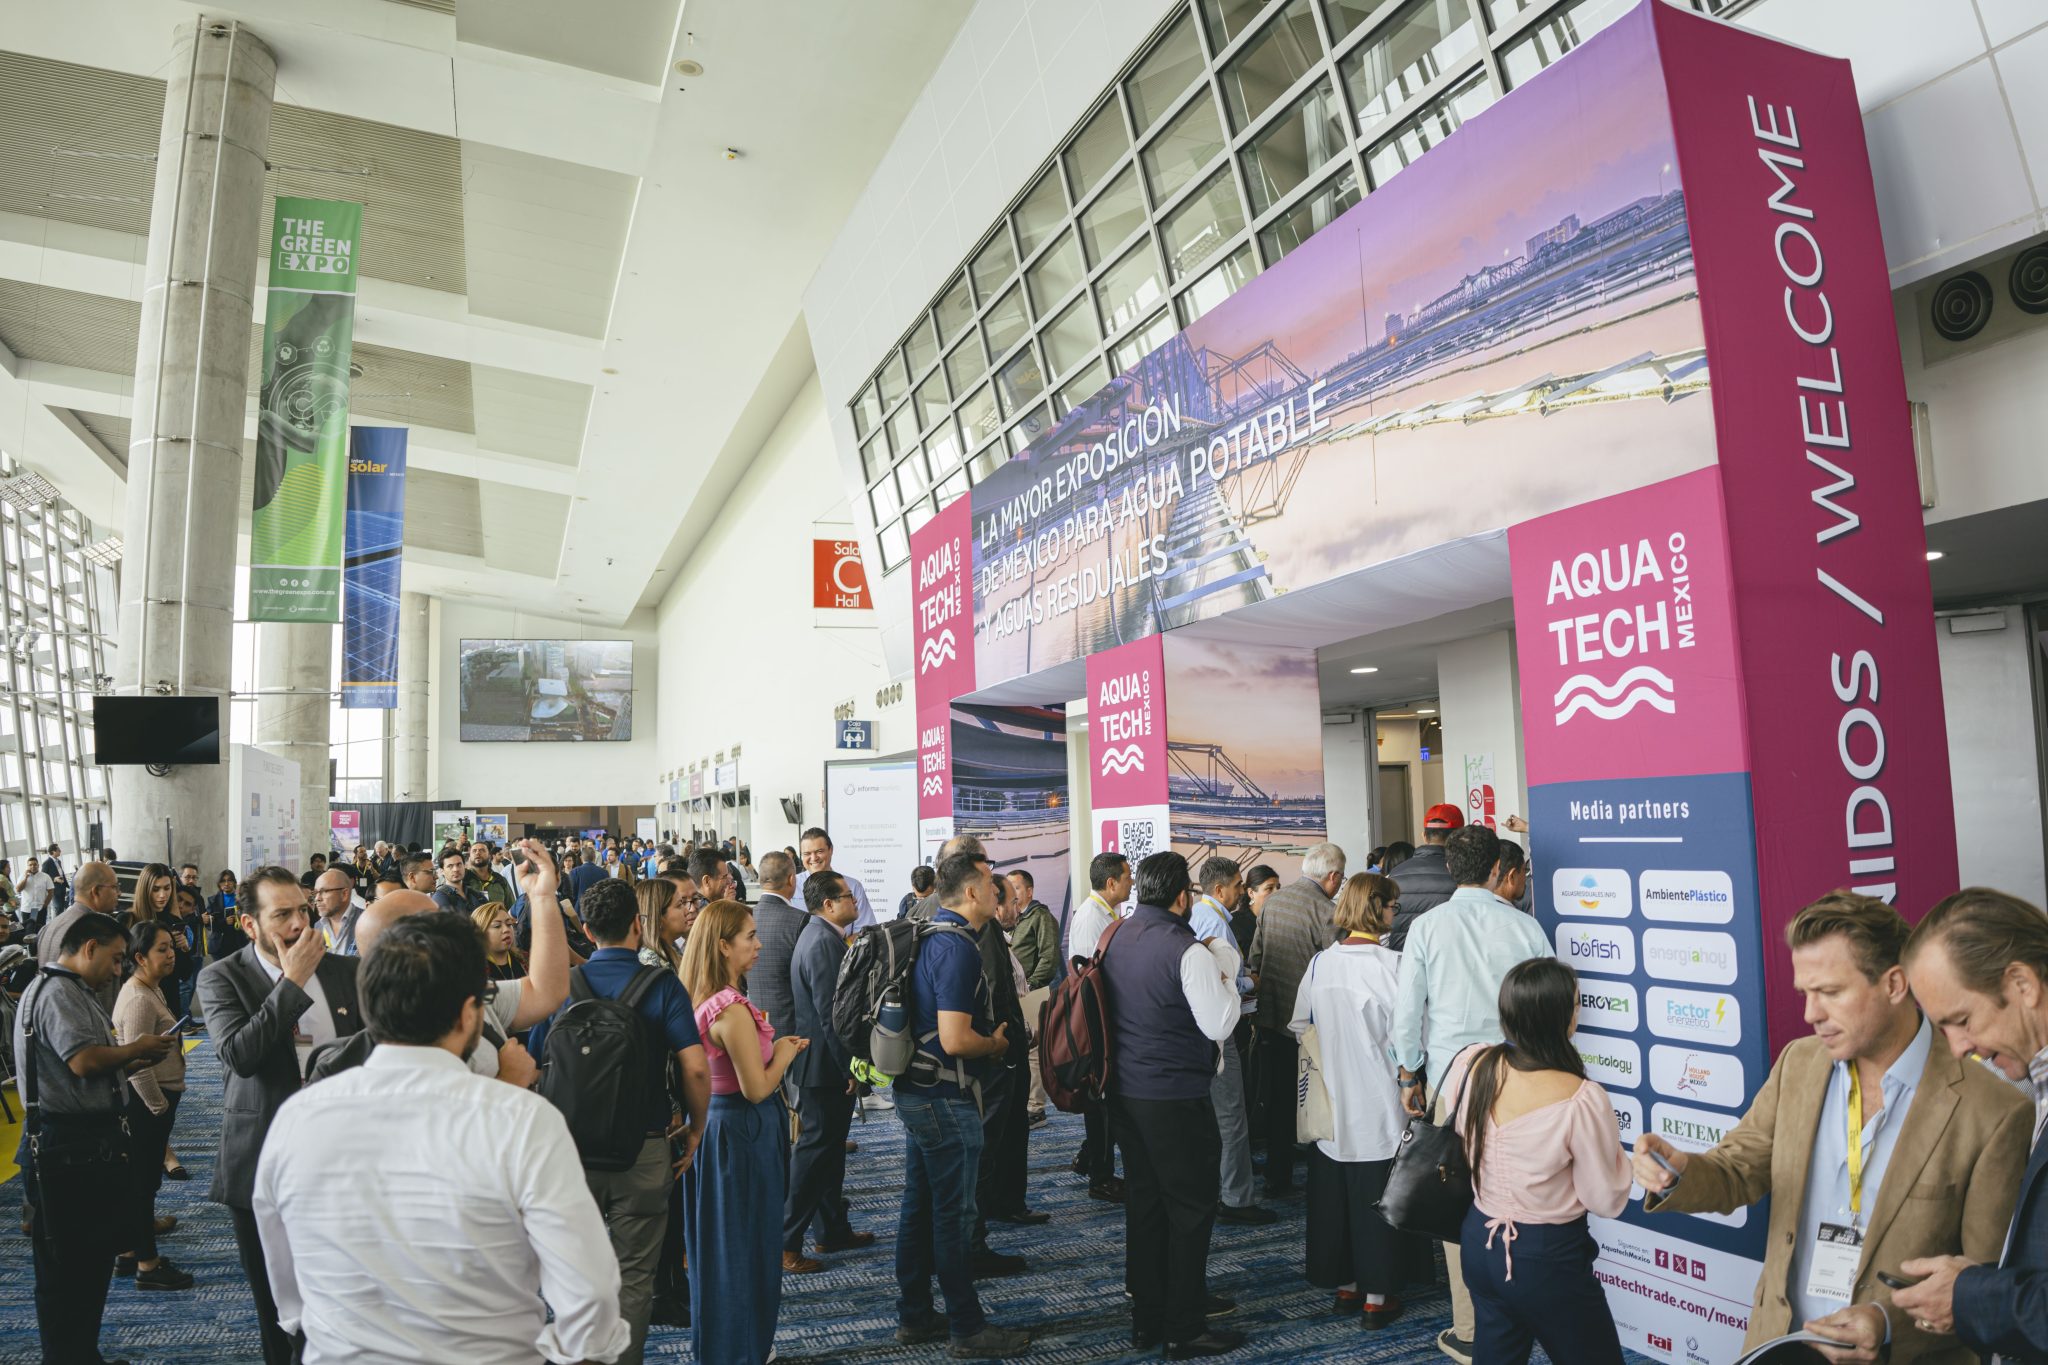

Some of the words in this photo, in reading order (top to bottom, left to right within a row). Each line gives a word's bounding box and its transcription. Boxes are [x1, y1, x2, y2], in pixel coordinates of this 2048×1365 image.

[282, 218, 324, 236] THE
[280, 235, 351, 256] GREEN
[280, 253, 348, 273] EXPO
[1747, 95, 1860, 544] WELCOME
[350, 460, 388, 473] solar
[981, 513, 998, 550] LA
[1001, 477, 1053, 537] MAYOR
[1056, 392, 1181, 503] EXPOSICIÓN
[982, 559, 999, 597] DE
[1002, 527, 1060, 585] MÉXICO
[1064, 498, 1115, 554] PARA
[1120, 461, 1185, 527] AGUA
[1190, 378, 1331, 492] POTABLE
[834, 542, 860, 555] Sala
[833, 556, 862, 593] C
[919, 542, 953, 592] AQUA
[1546, 538, 1664, 605] AQUA
[836, 594, 859, 607] Hall
[983, 612, 992, 645] Y
[995, 591, 1043, 639] AGUAS
[1047, 533, 1168, 620] RESIDUALES
[1668, 531, 1695, 648] MEXICO
[920, 583, 955, 633] TECH
[1548, 600, 1670, 666] TECH
[1100, 672, 1141, 707] AQUA
[1143, 670, 1152, 735] MEXICO
[922, 727, 941, 749] AQUA
[1100, 708, 1143, 743] TECH
[922, 750, 941, 774] TECH
[1570, 800, 1613, 820] Media
[1619, 800, 1689, 824] partners
[1646, 888, 1728, 902] AmbientePlástico
[1666, 1000, 1711, 1019] Factor
[1662, 1117, 1729, 1143] RETEM
[1601, 1243, 1651, 1264] AquatechMexico
[1593, 1270, 1748, 1331] quatechtrade.com/mexi
[1815, 1287, 1850, 1299] VISITANTE
[1647, 1333, 1672, 1352] rai
